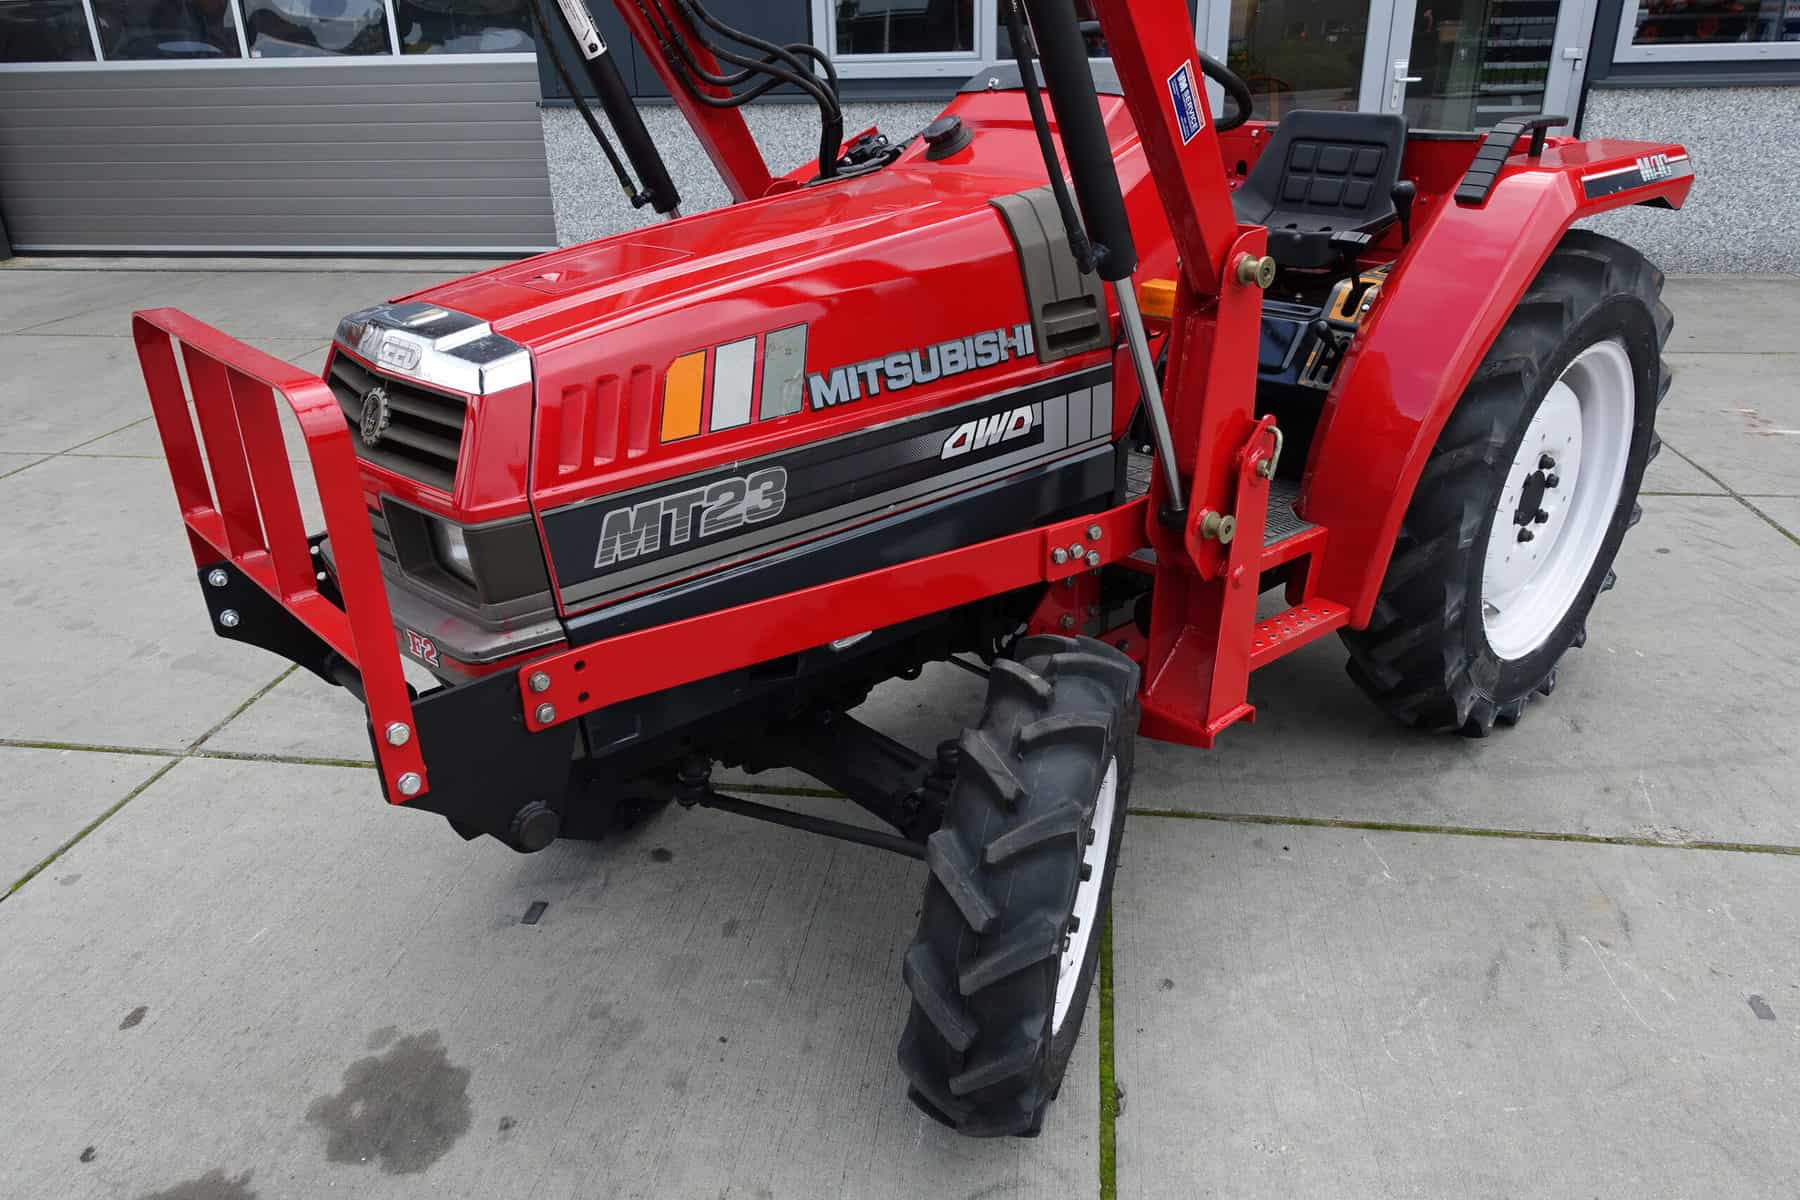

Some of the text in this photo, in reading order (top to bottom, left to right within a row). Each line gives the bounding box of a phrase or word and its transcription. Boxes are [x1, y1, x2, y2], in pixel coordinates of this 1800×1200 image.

[807, 323, 1035, 411] MITSUBISHI
[941, 405, 1034, 461] 4WD
[594, 466, 788, 569] MT23
[407, 628, 440, 668] F2
